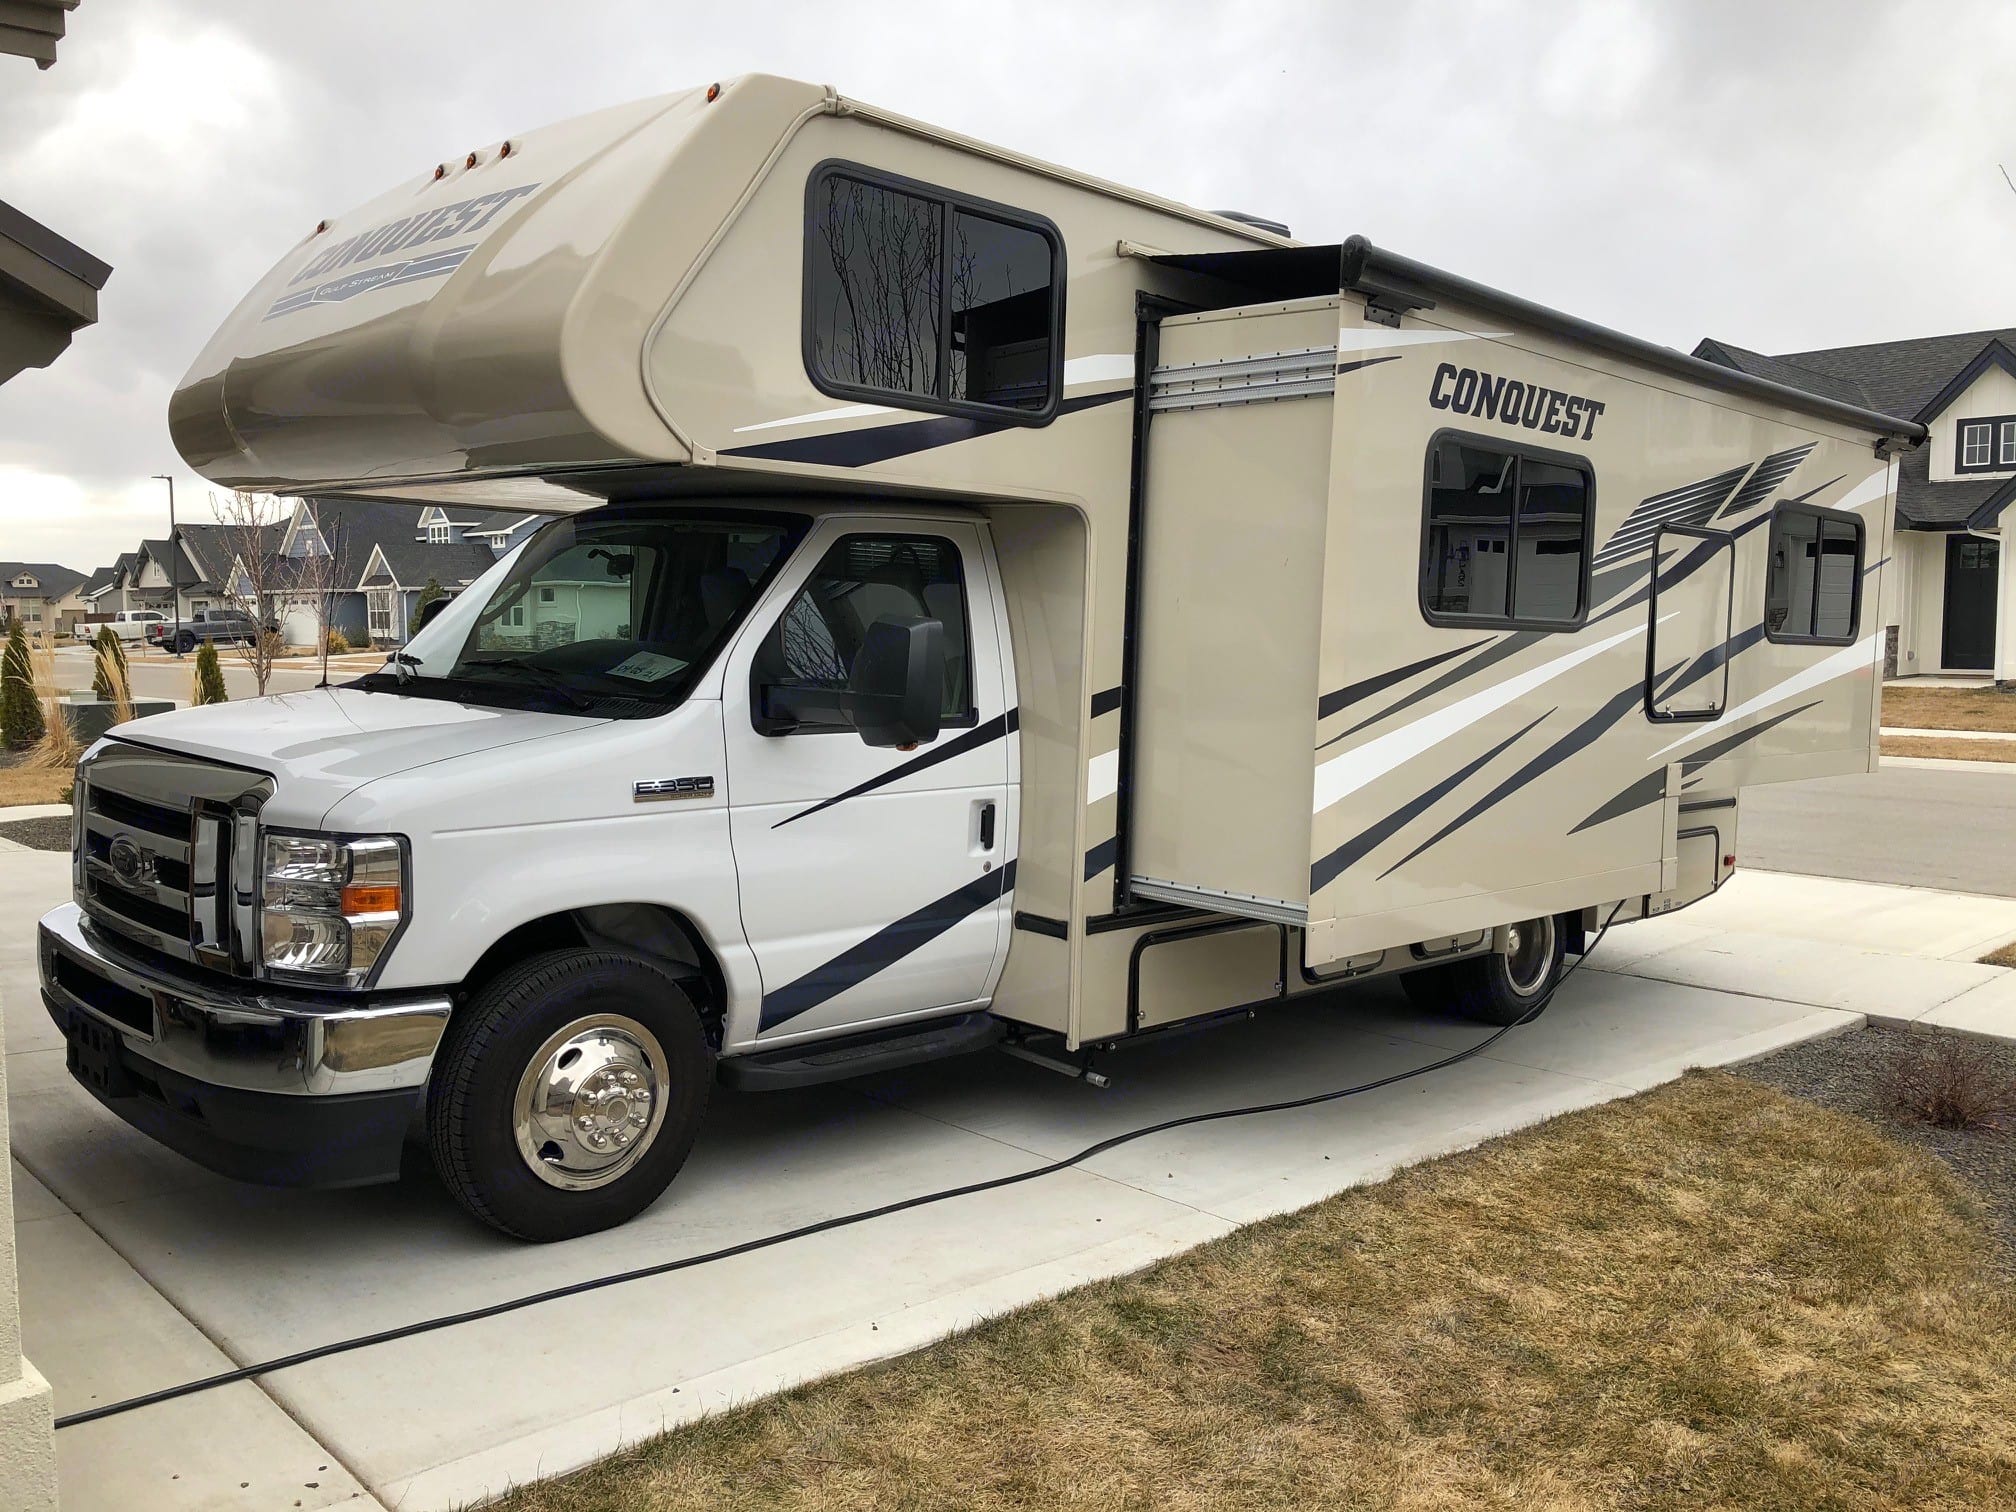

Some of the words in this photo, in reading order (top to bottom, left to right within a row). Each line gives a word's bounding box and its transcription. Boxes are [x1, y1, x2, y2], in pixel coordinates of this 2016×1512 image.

[287, 182, 543, 286] CONQUEST
[1429, 362, 1606, 441] CONQUEST
[636, 776, 714, 793] E-350
